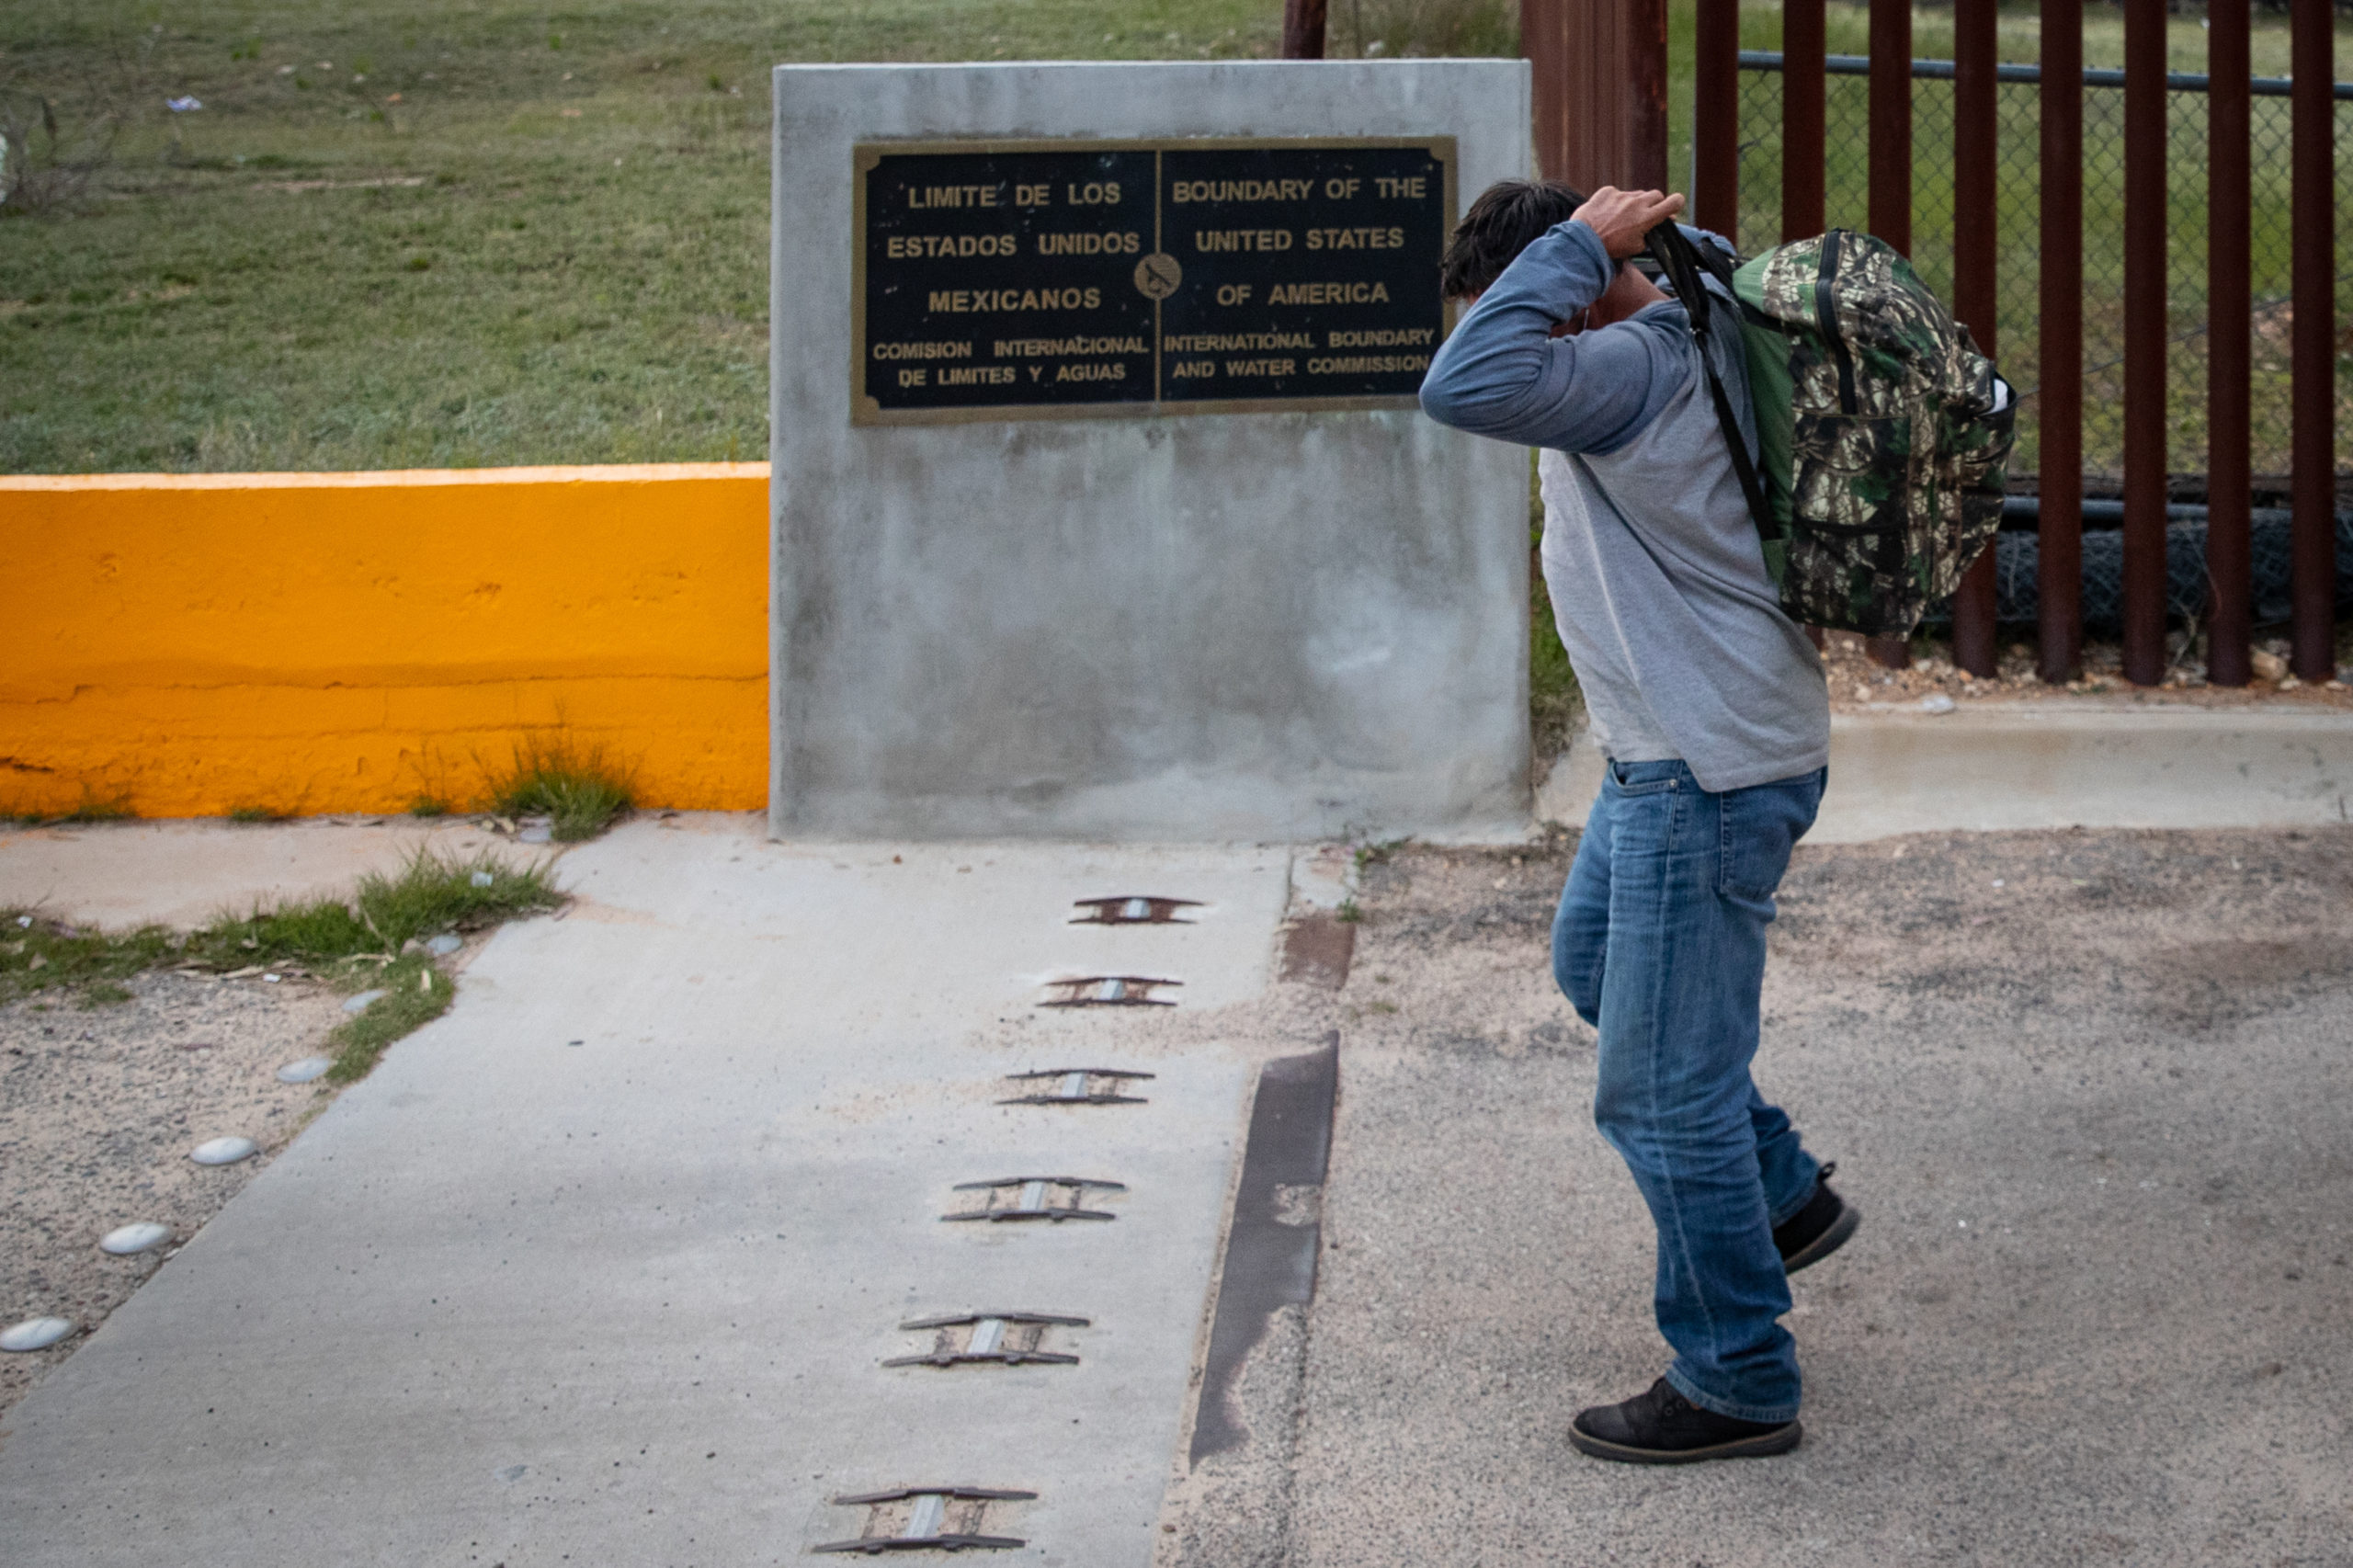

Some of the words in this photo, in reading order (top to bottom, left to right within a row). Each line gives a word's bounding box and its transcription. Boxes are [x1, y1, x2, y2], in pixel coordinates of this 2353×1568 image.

[909, 186, 997, 209] LIMITE
[1016, 185, 1050, 206] DE
[1069, 182, 1121, 205] LOS
[1172, 179, 1313, 202] BOUNDARY
[1325, 178, 1360, 199] OF
[1375, 176, 1427, 199] THE
[887, 234, 1017, 258] ESTADOS
[1039, 233, 1140, 256] UNIDOS
[1196, 230, 1292, 252] UNITED
[1306, 228, 1404, 250] STATES
[928, 289, 1101, 312] MEXICANOS
[1217, 284, 1252, 306] OF
[1267, 282, 1390, 305] AMERICA
[873, 341, 972, 359] COMISION
[994, 336, 1149, 358] INTERNACIONAL
[1164, 332, 1315, 352] INTERNATIONAL
[1328, 328, 1435, 347] BOUNDARY
[899, 369, 926, 386] DE
[938, 366, 1016, 385] LIMITES
[1029, 366, 1043, 381] Y
[1056, 363, 1126, 381] AGUAS
[1172, 361, 1215, 378] AND
[1226, 358, 1296, 376] WATER
[1307, 355, 1429, 374] COMMISSION
